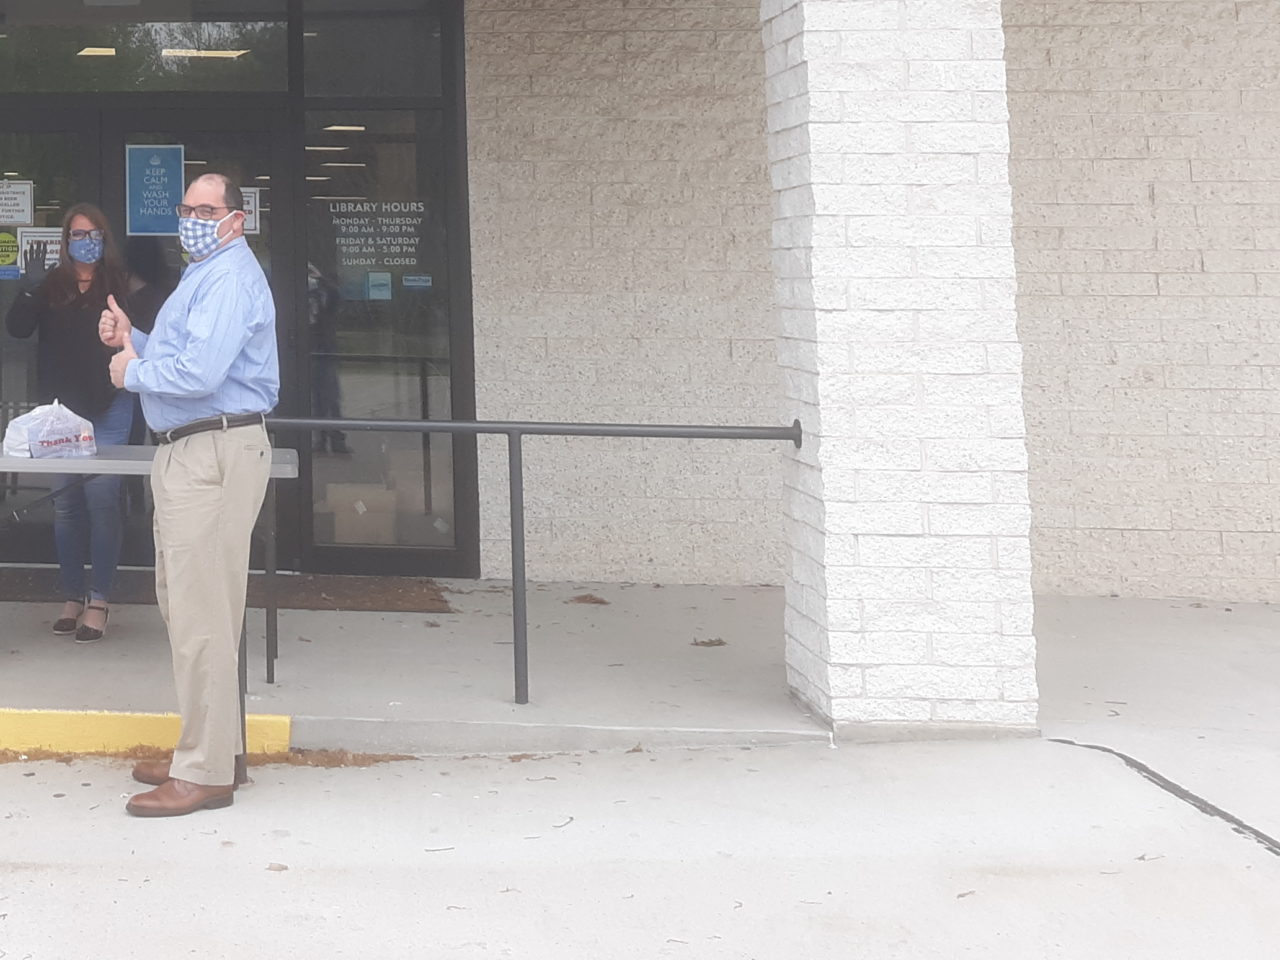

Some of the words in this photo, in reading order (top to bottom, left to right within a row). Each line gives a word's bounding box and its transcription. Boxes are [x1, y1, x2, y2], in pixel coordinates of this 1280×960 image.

[145, 168, 166, 176] KEEP
[143, 176, 168, 184] CALM
[143, 199, 169, 207] YOUR
[329, 202, 378, 212] LIBRARY
[382, 202, 425, 212] HOURS
[140, 207, 172, 215] HANDS
[332, 217, 370, 225] MONDAY
[335, 237, 366, 245] FRIDAY
[384, 257, 417, 265] CLOSED
[39, 436, 72, 446] Thank
